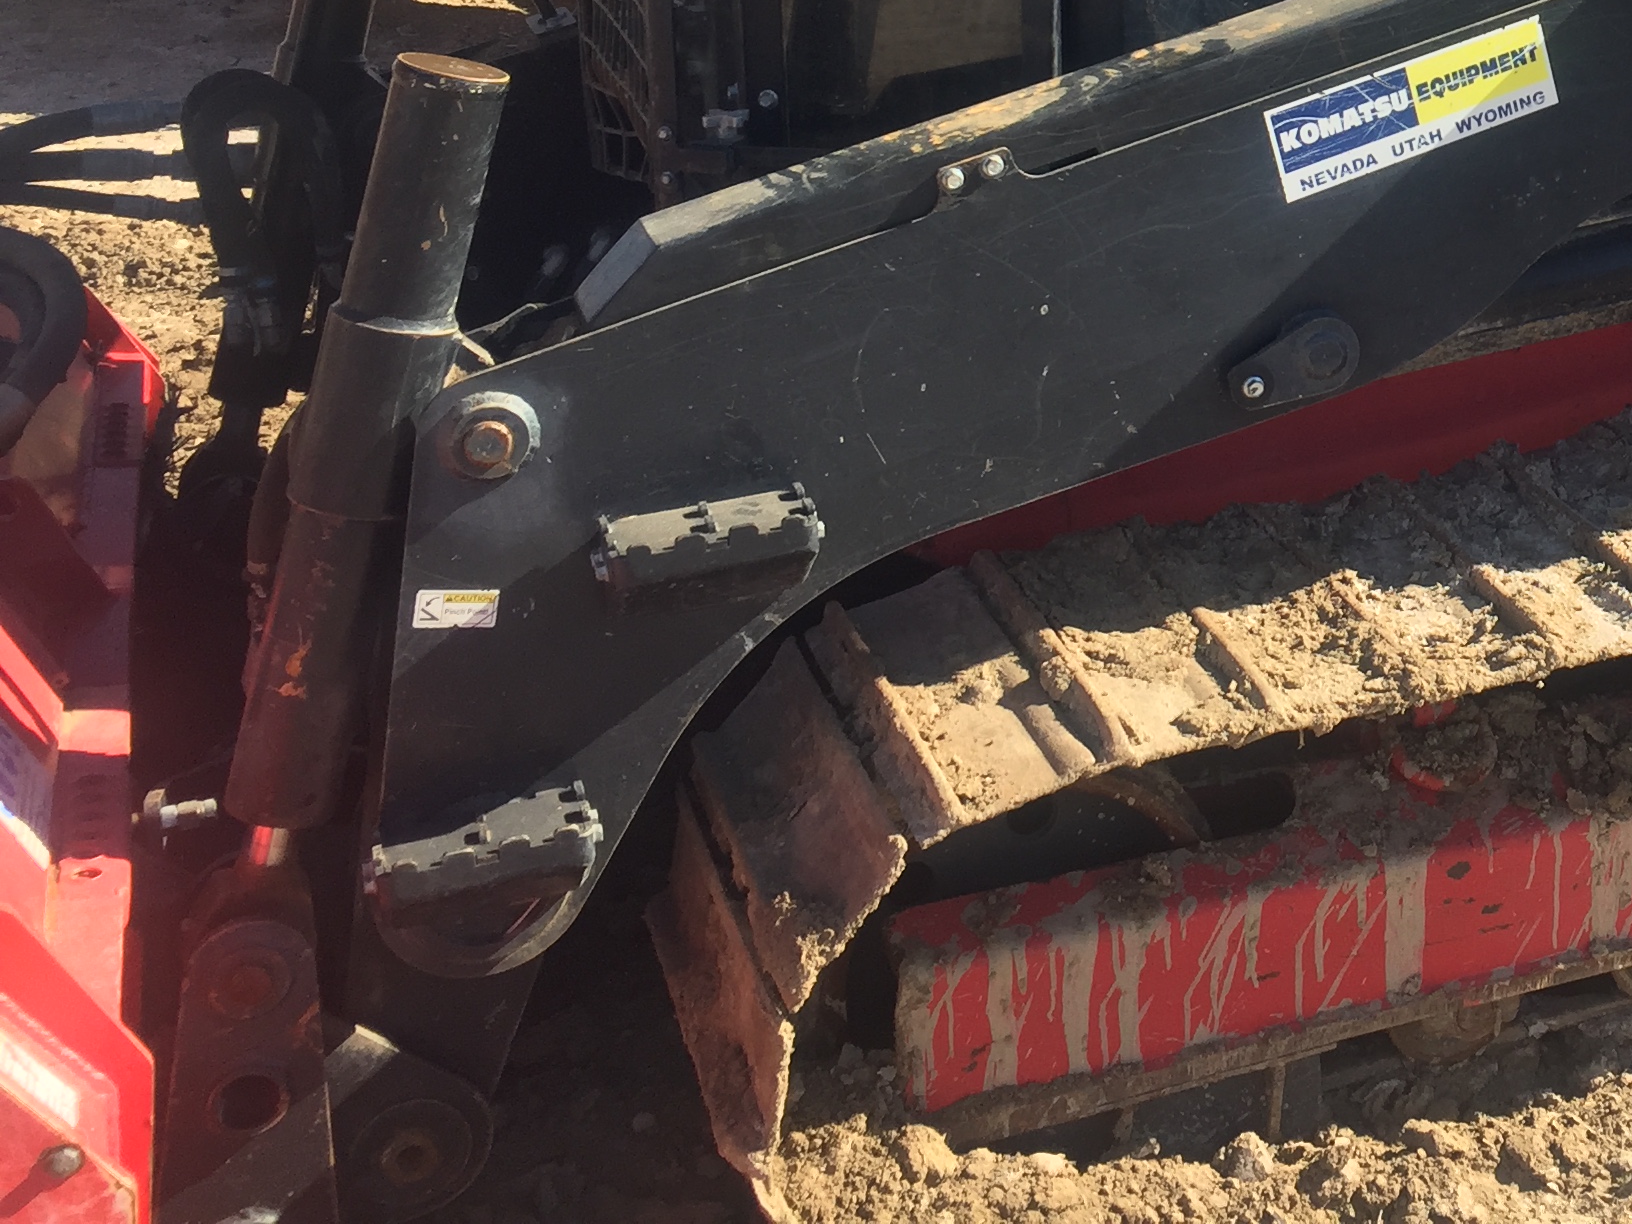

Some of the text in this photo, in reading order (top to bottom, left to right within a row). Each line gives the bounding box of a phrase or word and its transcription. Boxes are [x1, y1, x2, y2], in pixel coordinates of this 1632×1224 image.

[1280, 43, 1538, 152] KOMATSU EQUIPMENT
[1300, 91, 1546, 191] NEVADA UTAH WYOMING
[453, 595, 493, 603] CAUTION
